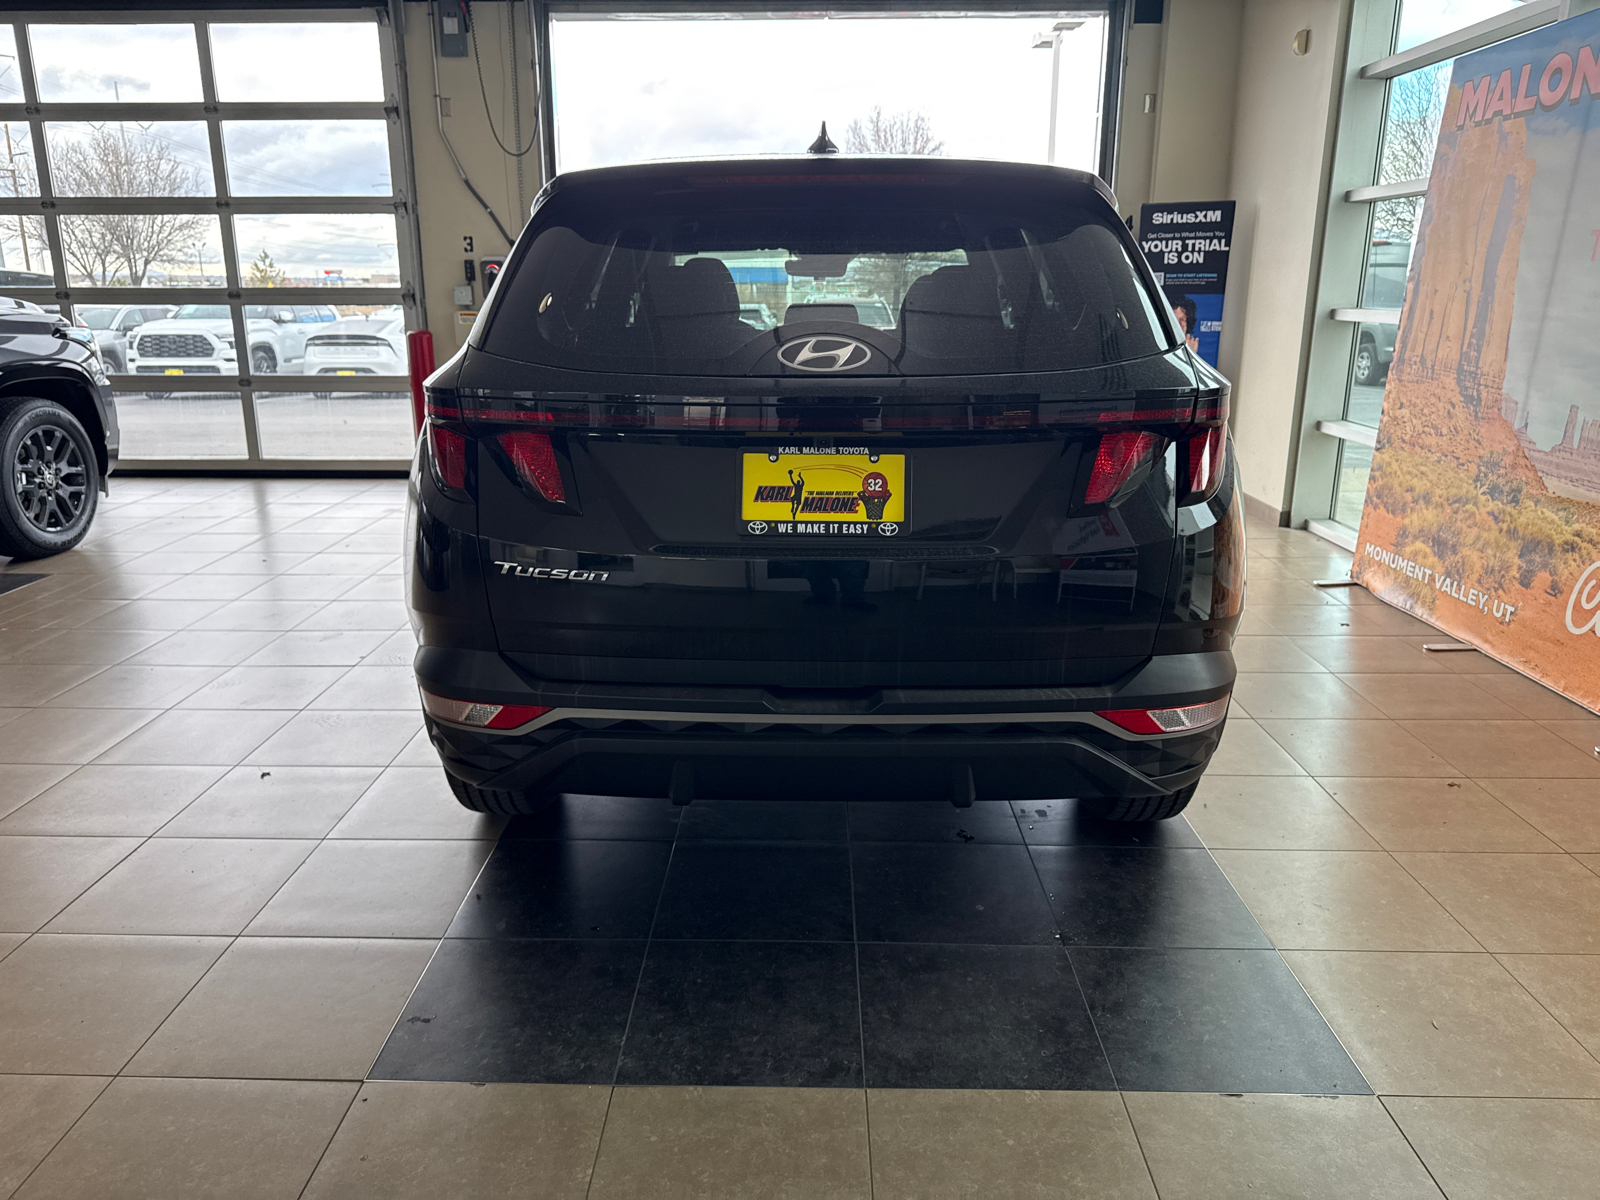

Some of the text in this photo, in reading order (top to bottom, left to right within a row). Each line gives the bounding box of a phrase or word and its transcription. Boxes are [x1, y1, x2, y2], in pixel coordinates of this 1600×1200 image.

[1456, 44, 1600, 130] MALON
[1152, 210, 1221, 224] SiriusXM
[463, 236, 473, 252] 3
[1141, 239, 1229, 253] YOUR TRIAL
[1164, 251, 1204, 264] IS ON
[838, 447, 869, 455] TOYOTA
[867, 479, 883, 491] 32
[753, 485, 794, 502] KARL
[800, 497, 860, 513] MALONE
[778, 523, 868, 534] WE MAKE IT EASY
[494, 561, 609, 581] Tucson
[1364, 542, 1515, 622] MONUMENT VALLEY, UT
